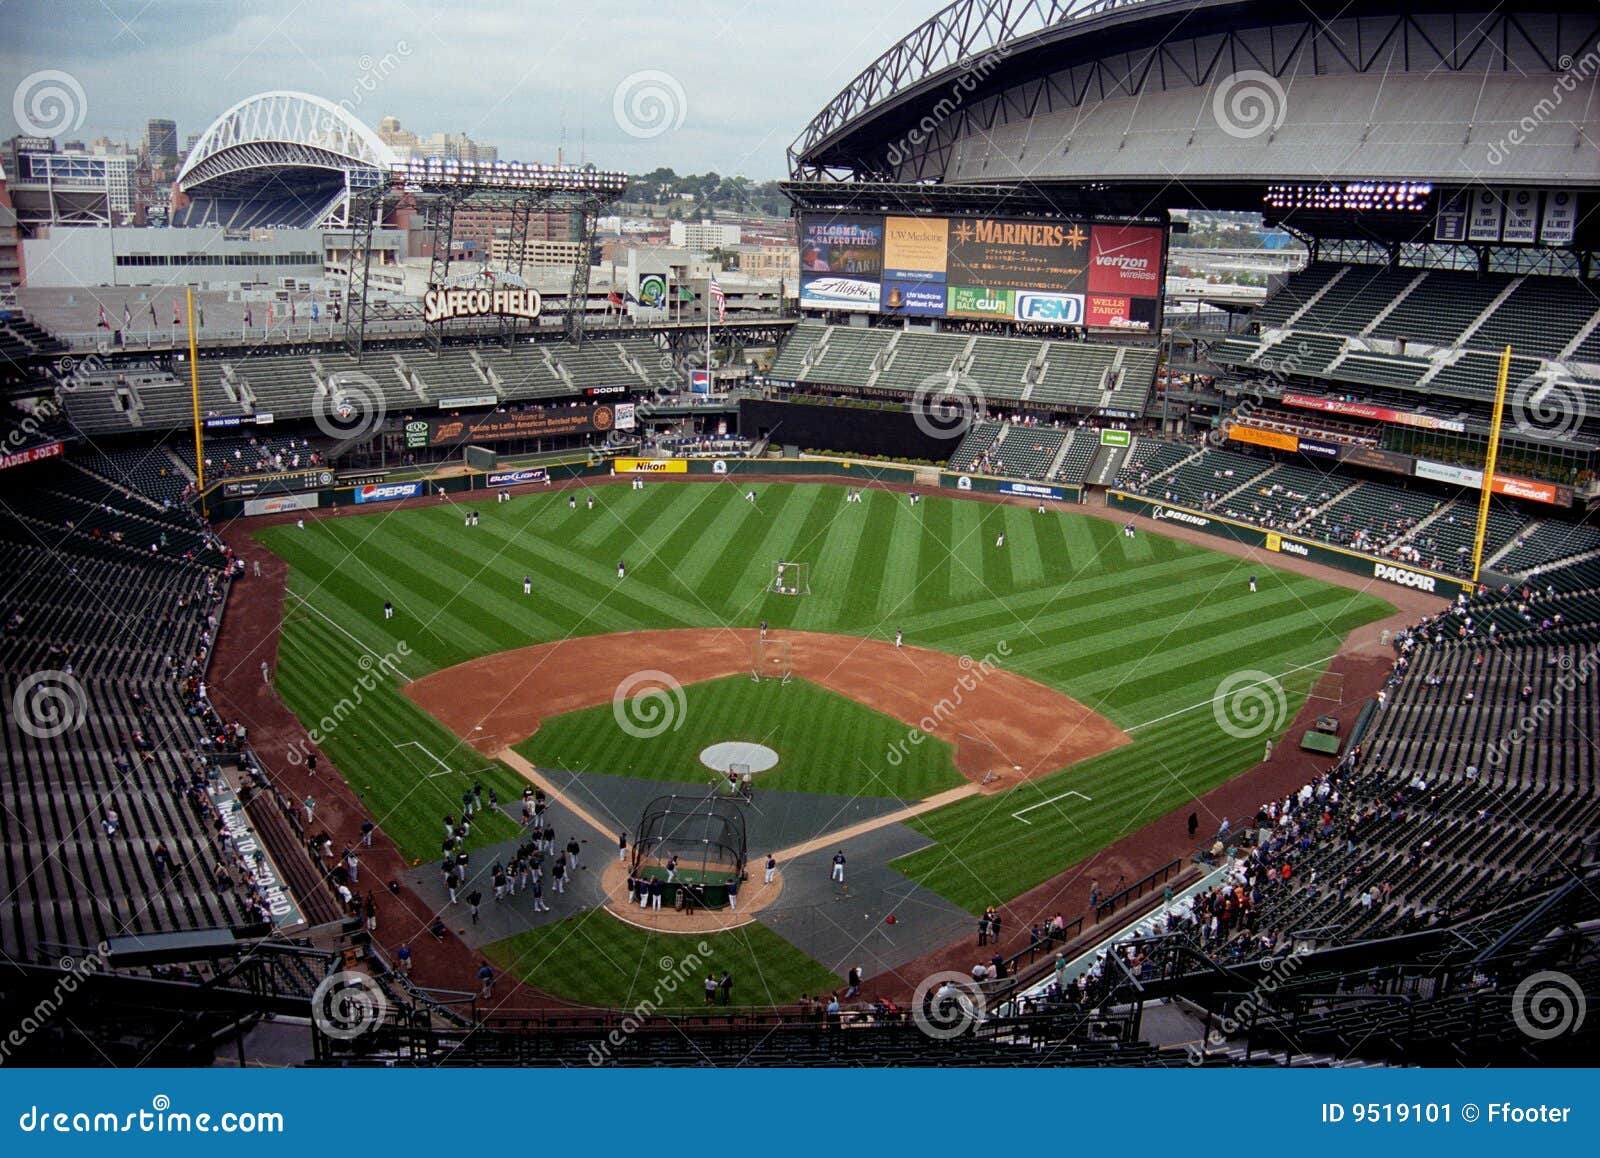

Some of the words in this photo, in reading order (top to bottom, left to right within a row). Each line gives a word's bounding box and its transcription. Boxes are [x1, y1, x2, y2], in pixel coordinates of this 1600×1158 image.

[809, 225, 857, 235] WELCOME
[908, 231, 943, 242] Medicine
[976, 220, 1064, 246] MARINERS
[817, 236, 850, 245] SAFECO
[852, 237, 878, 246] FIELD
[1096, 255, 1148, 270] verizon
[1120, 271, 1157, 280] wireless
[424, 288, 491, 322] SAFECO
[493, 288, 542, 319] FIELD
[1027, 298, 1072, 319] FSN
[1092, 298, 1125, 307] WELLS
[1092, 306, 1124, 314] FARGO
[593, 386, 625, 394] DODGE
[1335, 402, 1376, 416] Budweiser
[33, 444, 60, 460] JOE'S
[636, 462, 667, 472] Nikon
[515, 471, 543, 479] LIGHT
[375, 484, 416, 497] PEPSI
[1503, 484, 1549, 501] Microsoft
[1165, 510, 1207, 526] BOEING
[1281, 540, 1309, 556] WaMu
[1374, 563, 1435, 592] PACCAR
[237, 838, 257, 852] TO
[265, 886, 291, 915] FIELD
